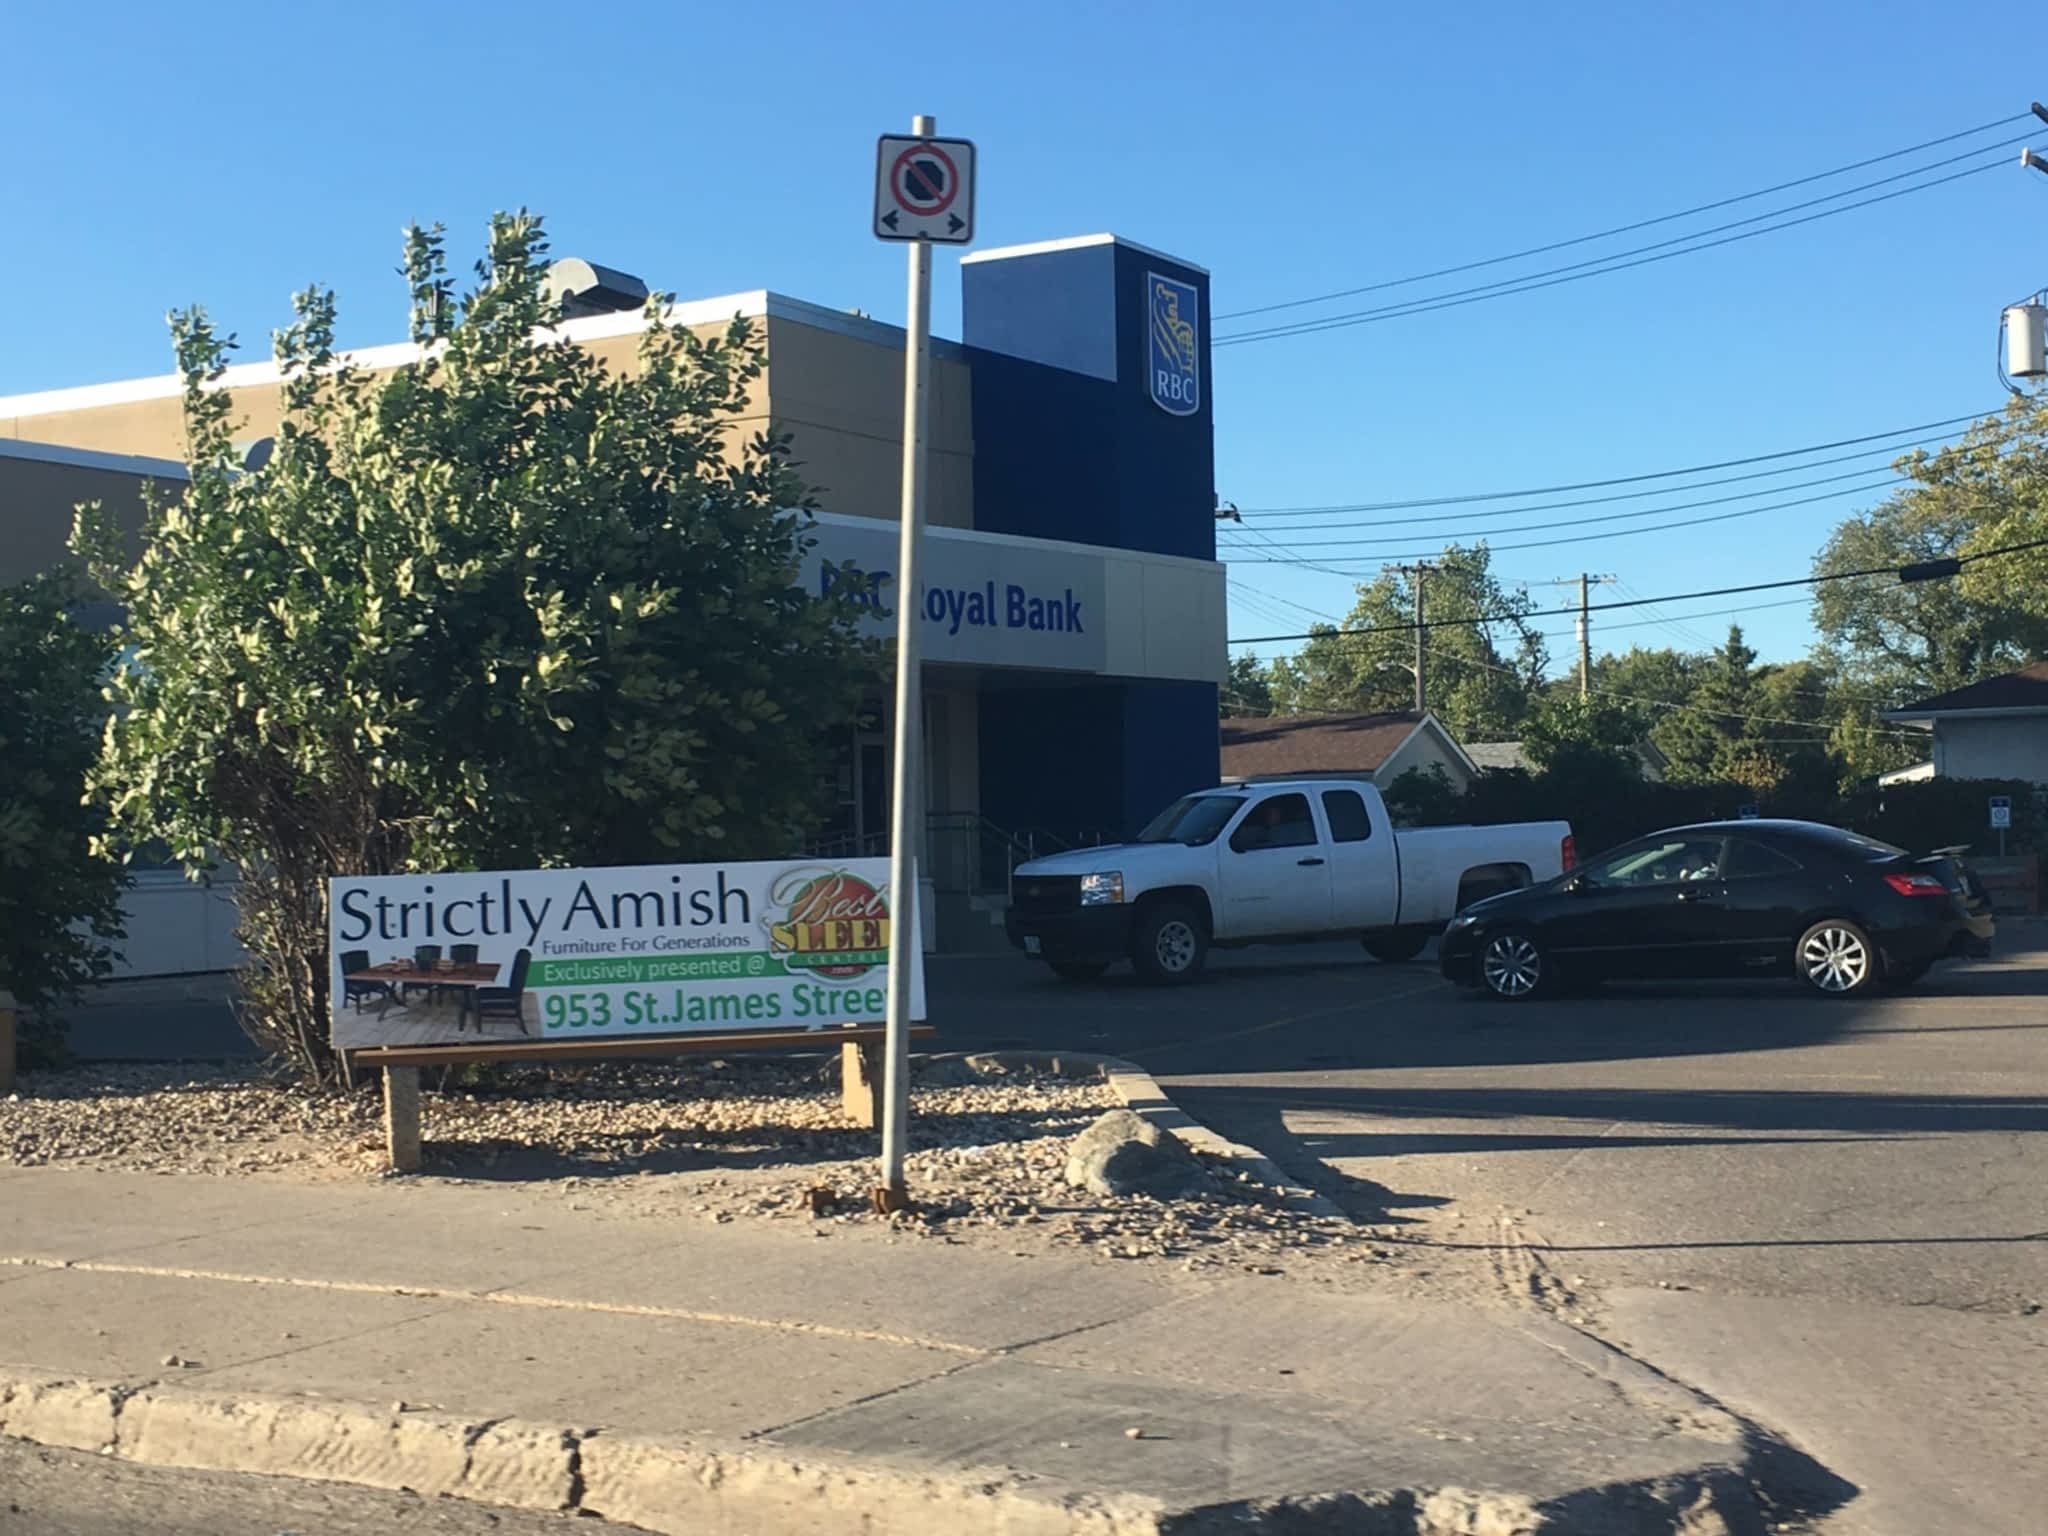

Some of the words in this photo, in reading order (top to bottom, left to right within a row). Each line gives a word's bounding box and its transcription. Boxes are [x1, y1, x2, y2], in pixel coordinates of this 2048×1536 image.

[1157, 369, 1194, 404] RBC
[920, 579, 998, 636] oyal
[1006, 584, 1084, 634] Bank
[341, 879, 552, 946] Strictly
[562, 871, 751, 932] Amish
[767, 865, 889, 926] Best
[542, 938, 617, 955] Furniture
[621, 936, 648, 952] For
[652, 933, 751, 950] Generations
[544, 961, 643, 982] Exclusively
[648, 956, 741, 979] presented
[746, 955, 766, 975] @
[545, 991, 613, 1029] 953
[623, 988, 782, 1025] St.James
[792, 983, 888, 1017] Stree
